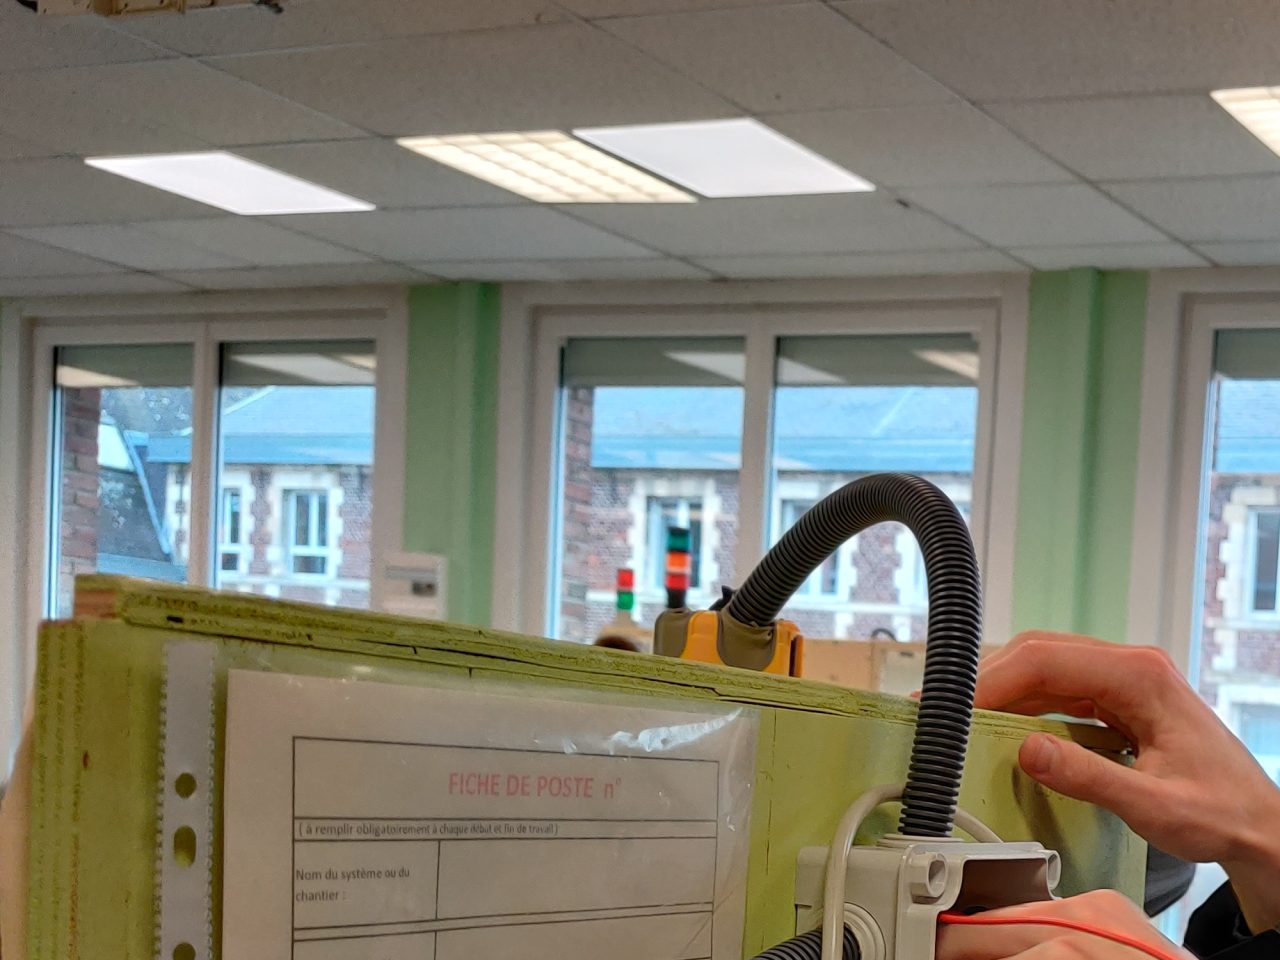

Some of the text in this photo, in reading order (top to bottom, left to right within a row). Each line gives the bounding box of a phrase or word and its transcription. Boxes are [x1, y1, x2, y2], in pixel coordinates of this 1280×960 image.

[449, 772, 500, 796] FICHE
[506, 775, 531, 796] DE
[536, 776, 595, 798] POSTE
[315, 823, 354, 837] remplir
[356, 823, 430, 837] obligatoirement
[439, 823, 468, 836] chaque
[470, 824, 492, 834] début
[493, 824, 502, 834] et
[504, 823, 516, 834] fin
[517, 823, 528, 834] de
[296, 866, 410, 882] Nom du système ou du
[295, 890, 339, 901] chantier
